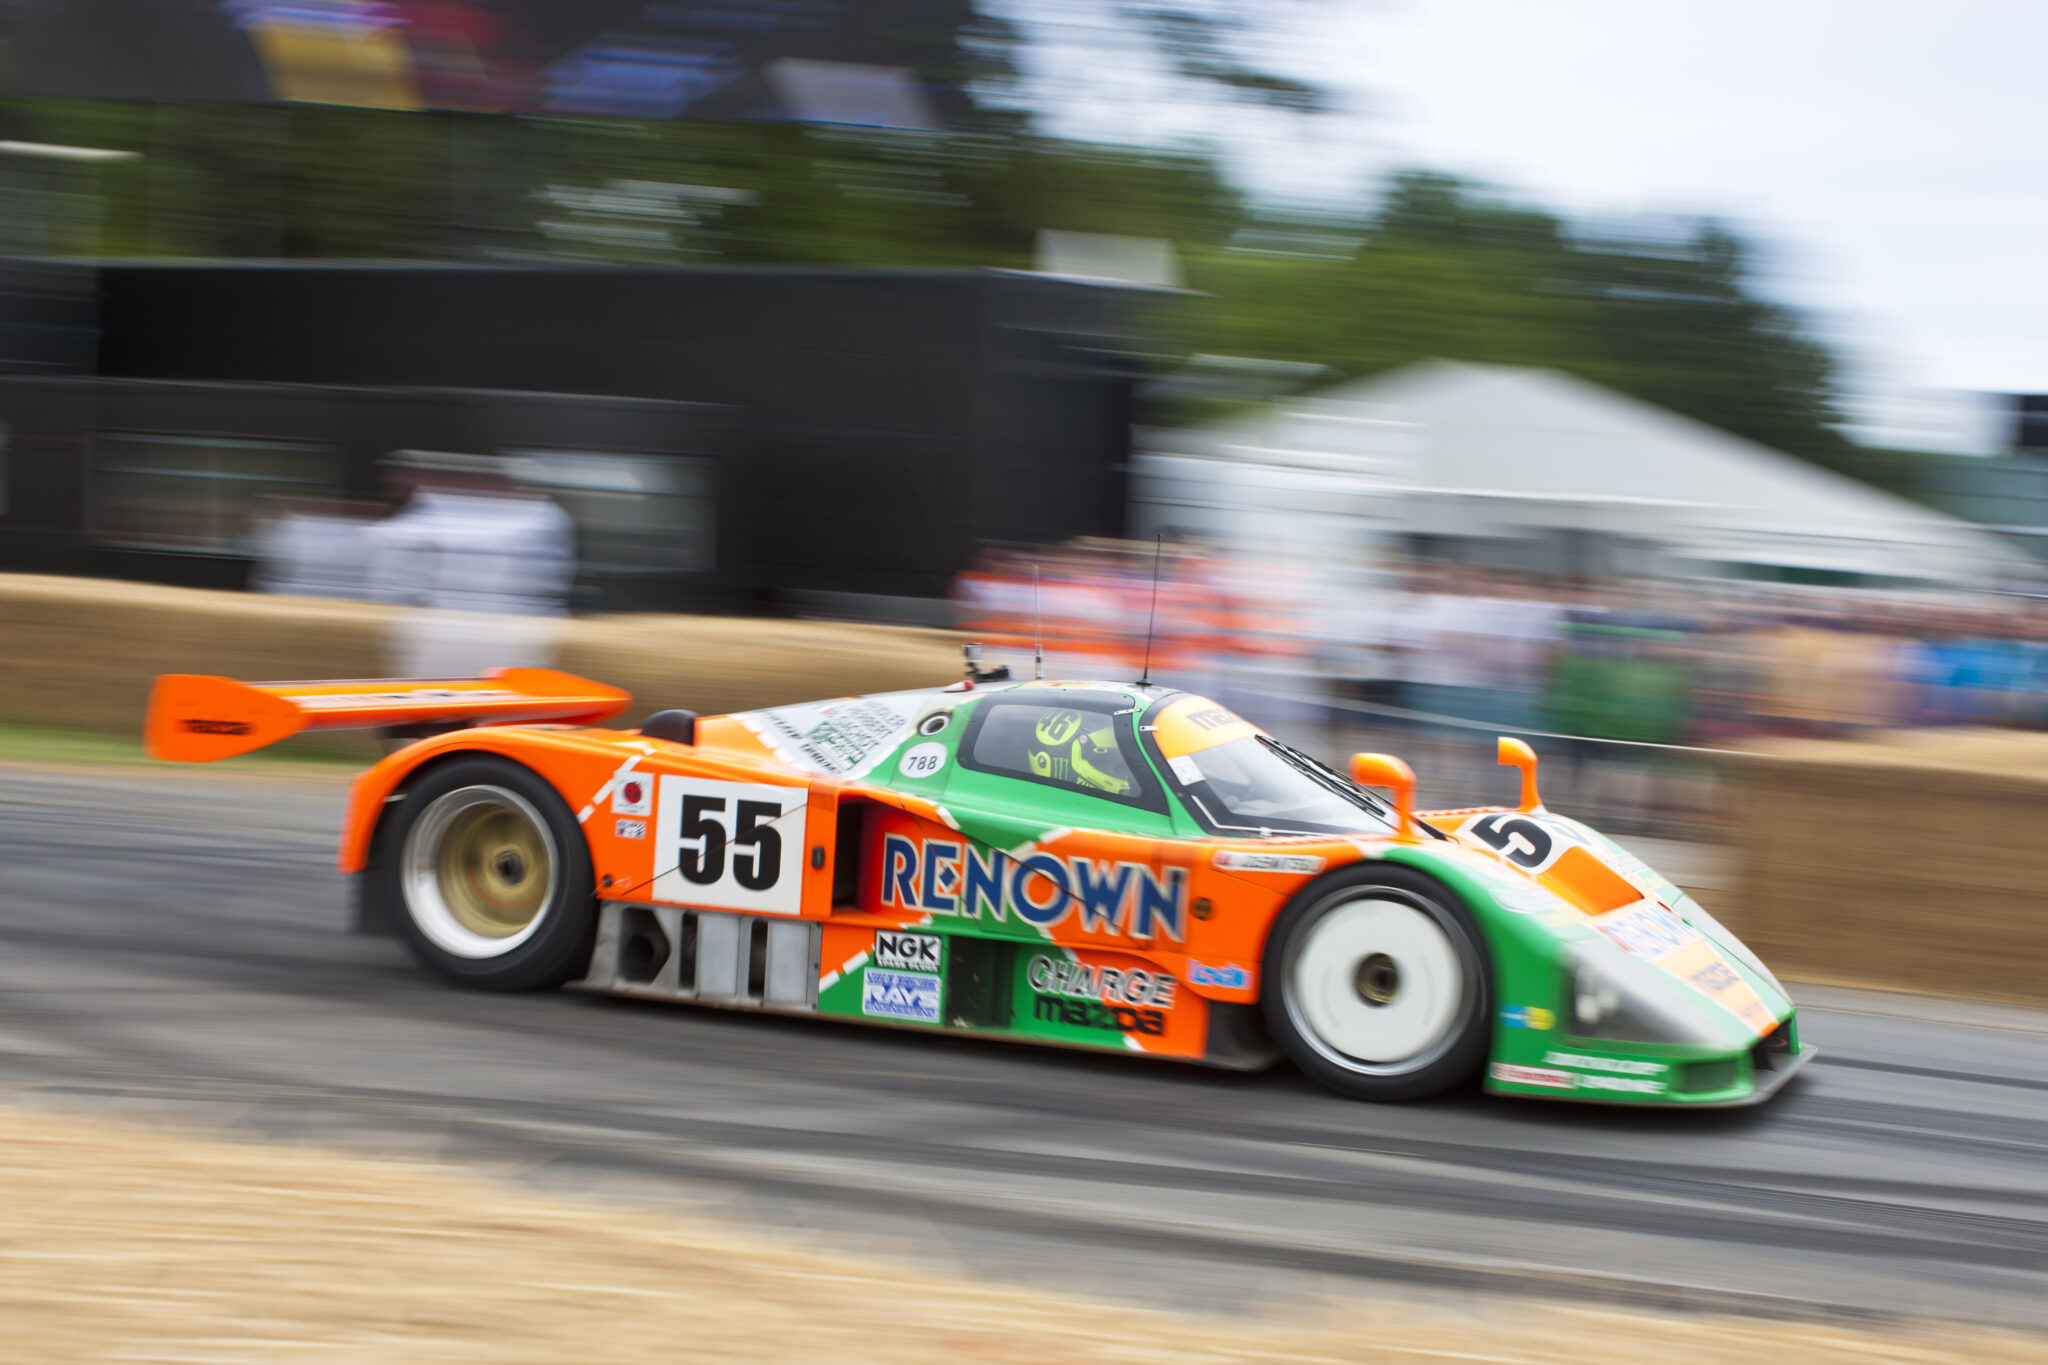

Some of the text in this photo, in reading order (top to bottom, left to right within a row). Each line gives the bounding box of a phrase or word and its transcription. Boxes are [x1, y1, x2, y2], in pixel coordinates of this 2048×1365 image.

[906, 755, 937, 771] 788
[678, 793, 783, 892] 55
[881, 831, 1191, 943] RENOWN
[878, 934, 938, 961] NGK
[866, 984, 940, 1008] RAYS
[1026, 953, 1180, 1010] CHARGE
